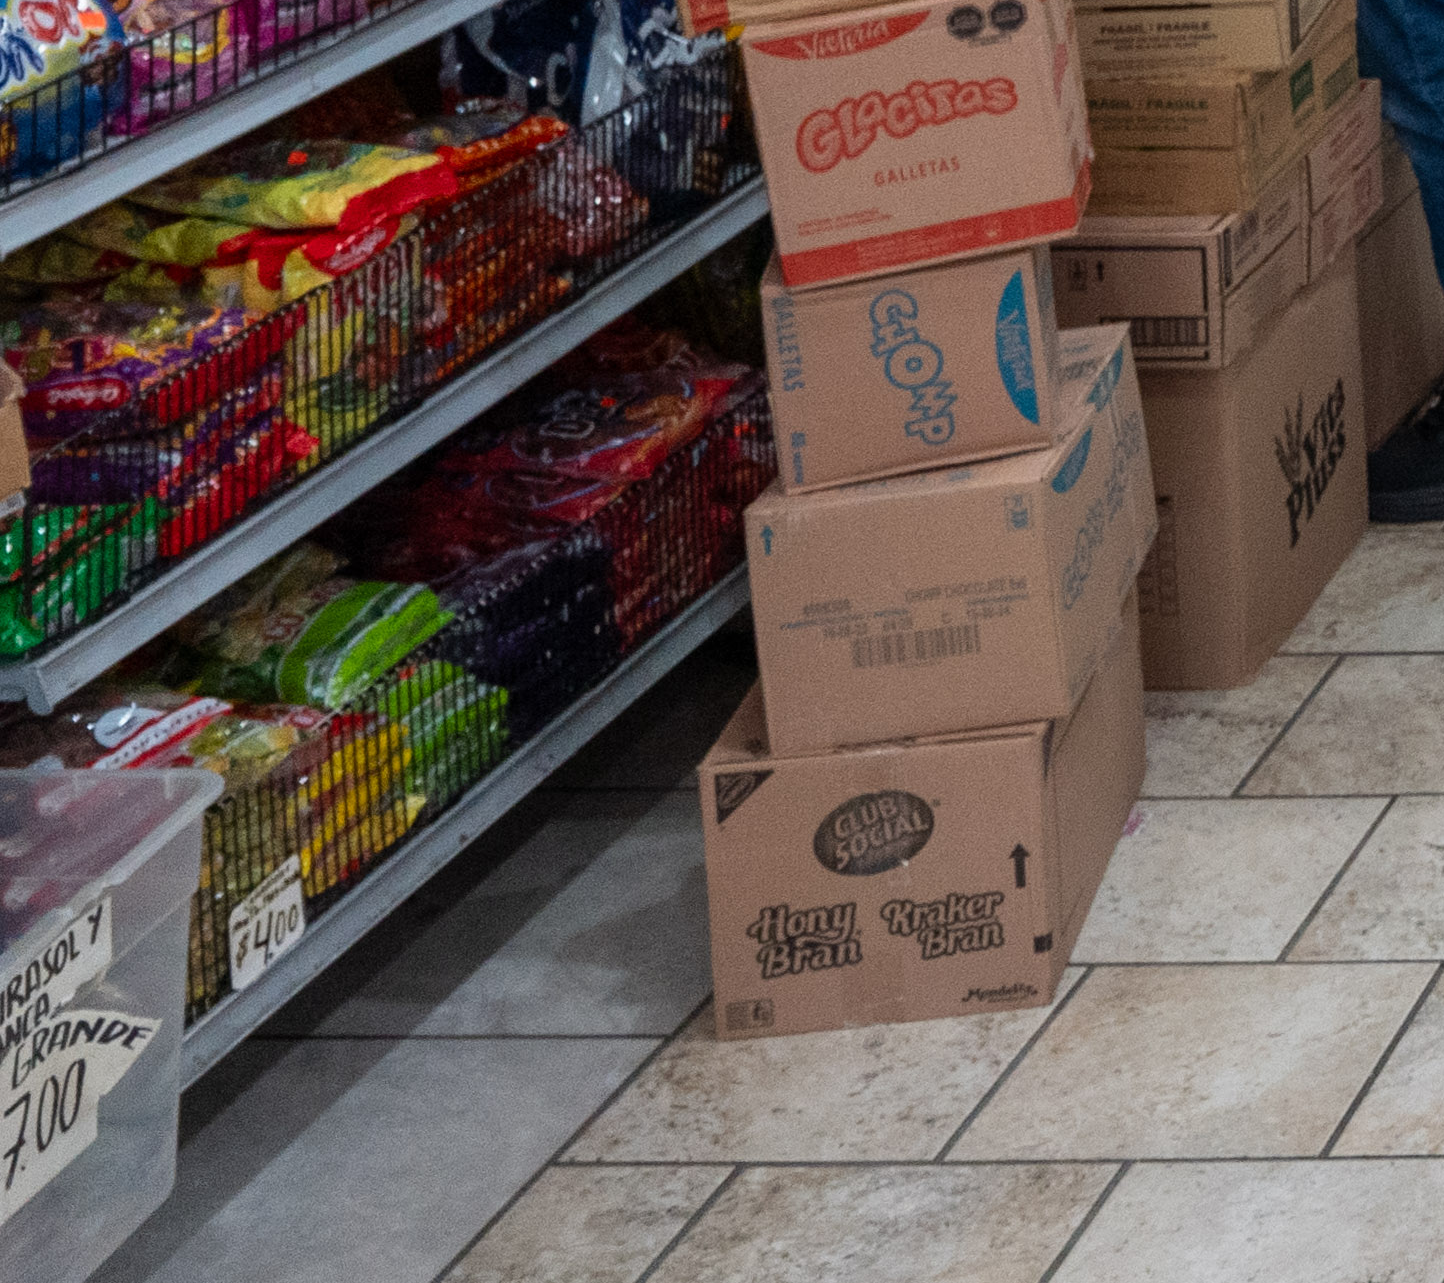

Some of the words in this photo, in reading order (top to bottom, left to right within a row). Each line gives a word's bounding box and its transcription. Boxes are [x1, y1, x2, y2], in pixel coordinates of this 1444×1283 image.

[873, 156, 961, 187] GALLETAS
[835, 796, 899, 840] CLUB
[835, 810, 930, 870] SOCIAL
[746, 901, 862, 944] Hony
[880, 891, 1005, 936] Kraker
[756, 937, 865, 980] Bran
[917, 922, 1005, 962] Bran
[11, 1018, 154, 1091] GRANDE
